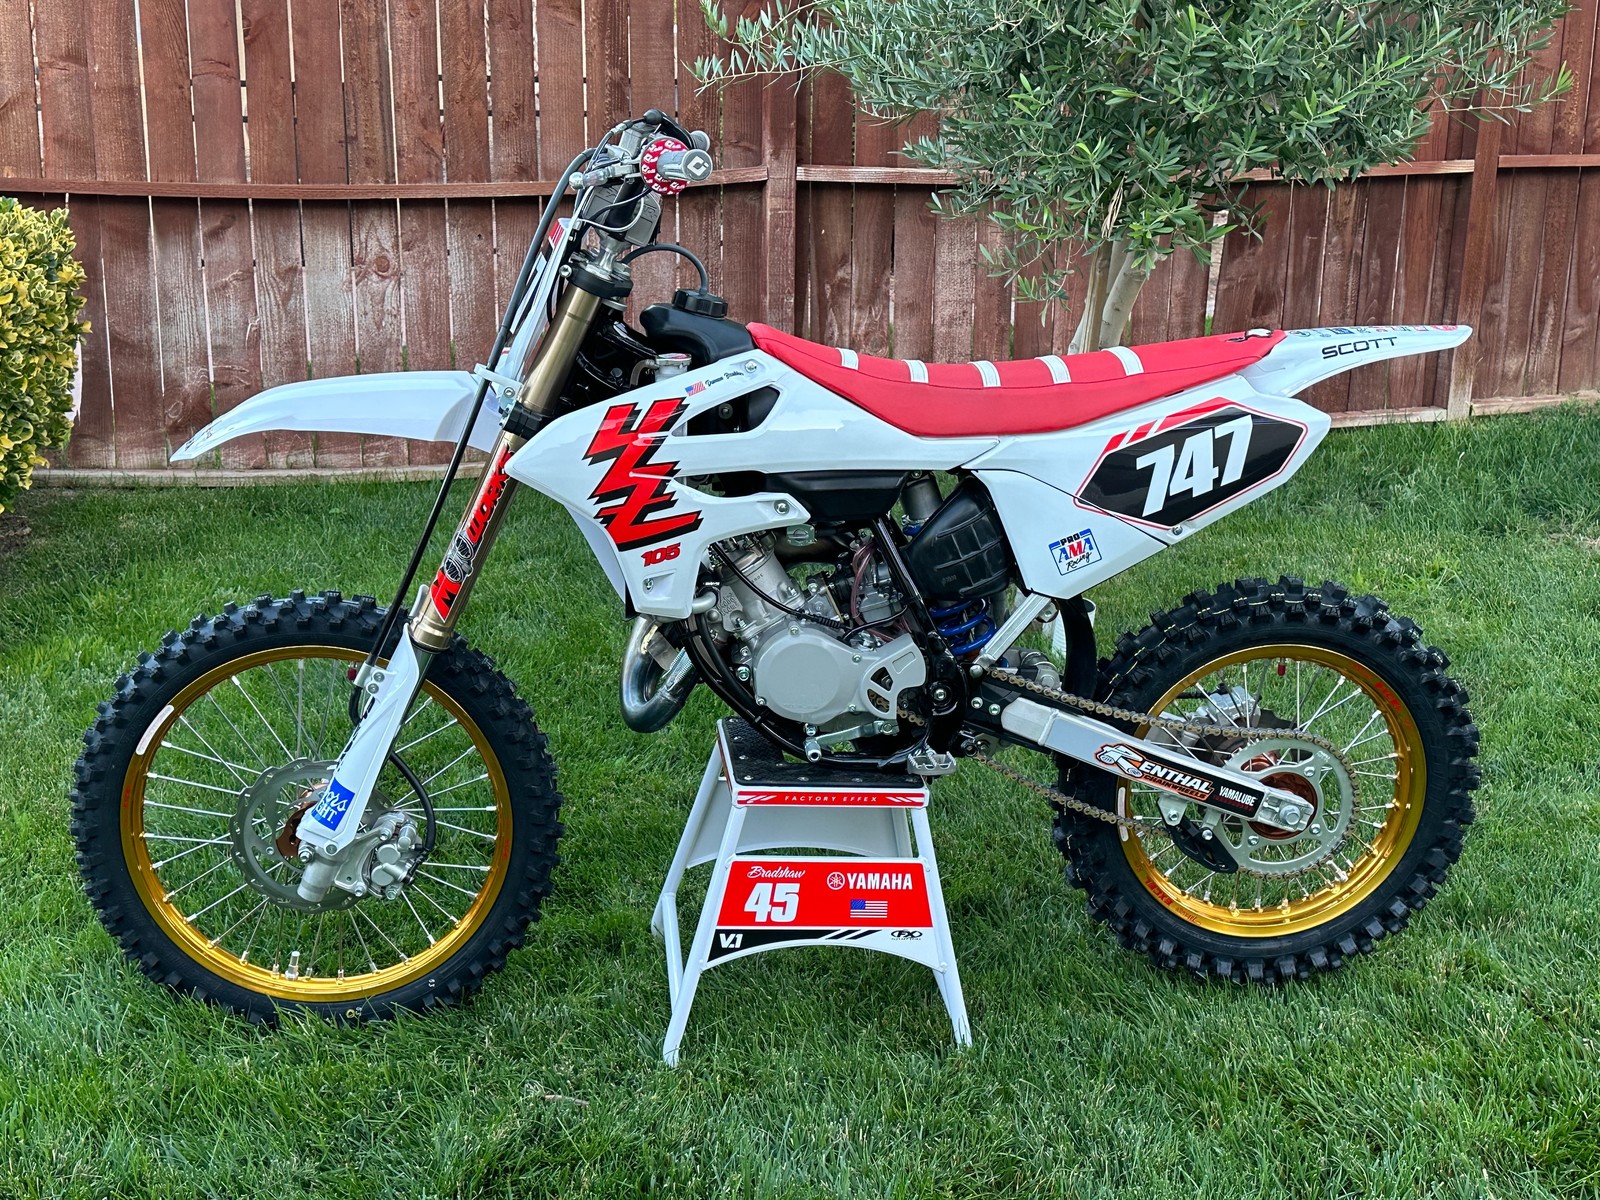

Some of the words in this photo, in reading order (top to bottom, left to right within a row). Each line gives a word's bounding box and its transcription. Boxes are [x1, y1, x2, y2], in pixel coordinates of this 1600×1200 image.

[1322, 336, 1398, 360] SCOTT
[1136, 415, 1253, 518] 747
[1059, 537, 1094, 563] AMA
[1060, 533, 1080, 546] PRO
[641, 542, 681, 567] 105
[1066, 552, 1092, 571] Racing
[1096, 744, 1213, 794] RENTHAL
[1143, 773, 1208, 799] CHAINWHEELS
[1219, 785, 1256, 807] YAMALUBE
[843, 795, 877, 803] EFFEX
[747, 865, 806, 879] Bradshaw
[847, 872, 913, 890] YAMAHA
[743, 882, 801, 923] 45
